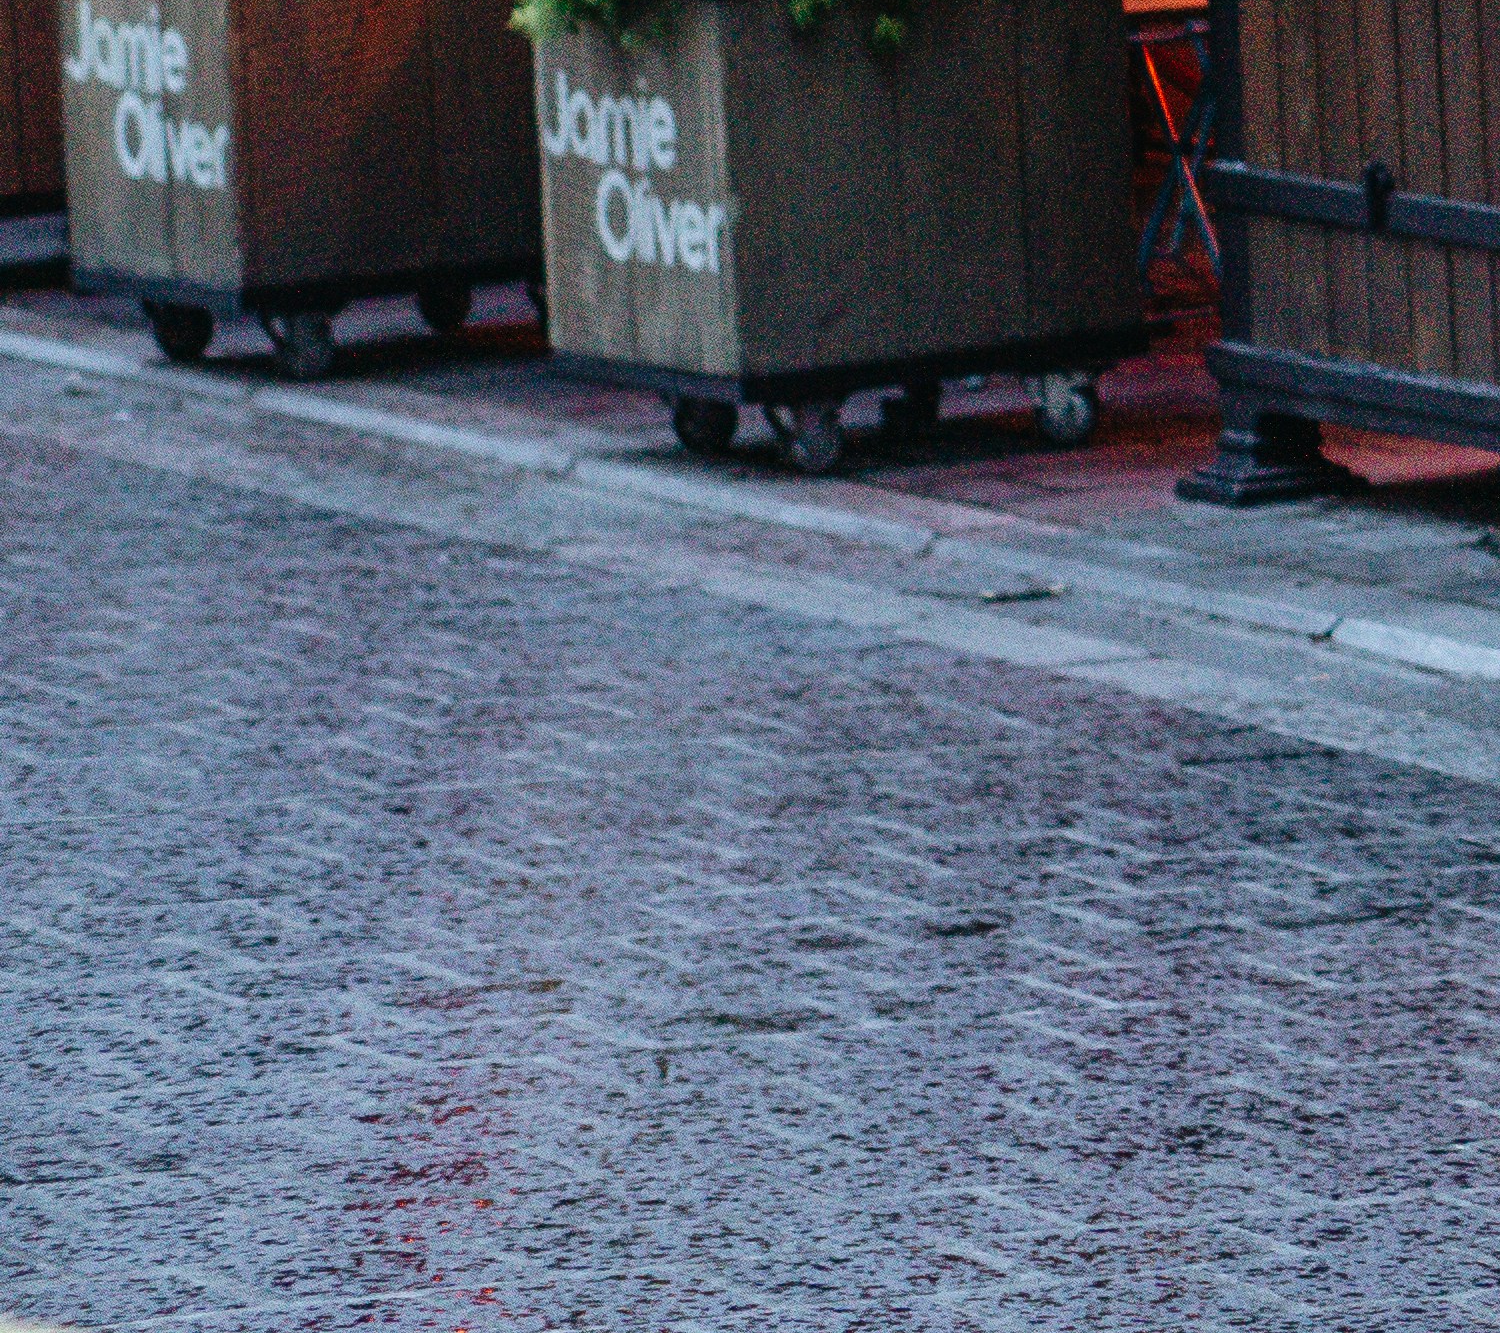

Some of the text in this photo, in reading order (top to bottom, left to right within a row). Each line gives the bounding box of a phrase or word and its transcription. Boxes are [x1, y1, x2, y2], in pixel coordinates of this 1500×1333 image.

[114, 90, 233, 190] Oliver
[541, 70, 677, 171] Jamie
[597, 171, 729, 275] Oliver
